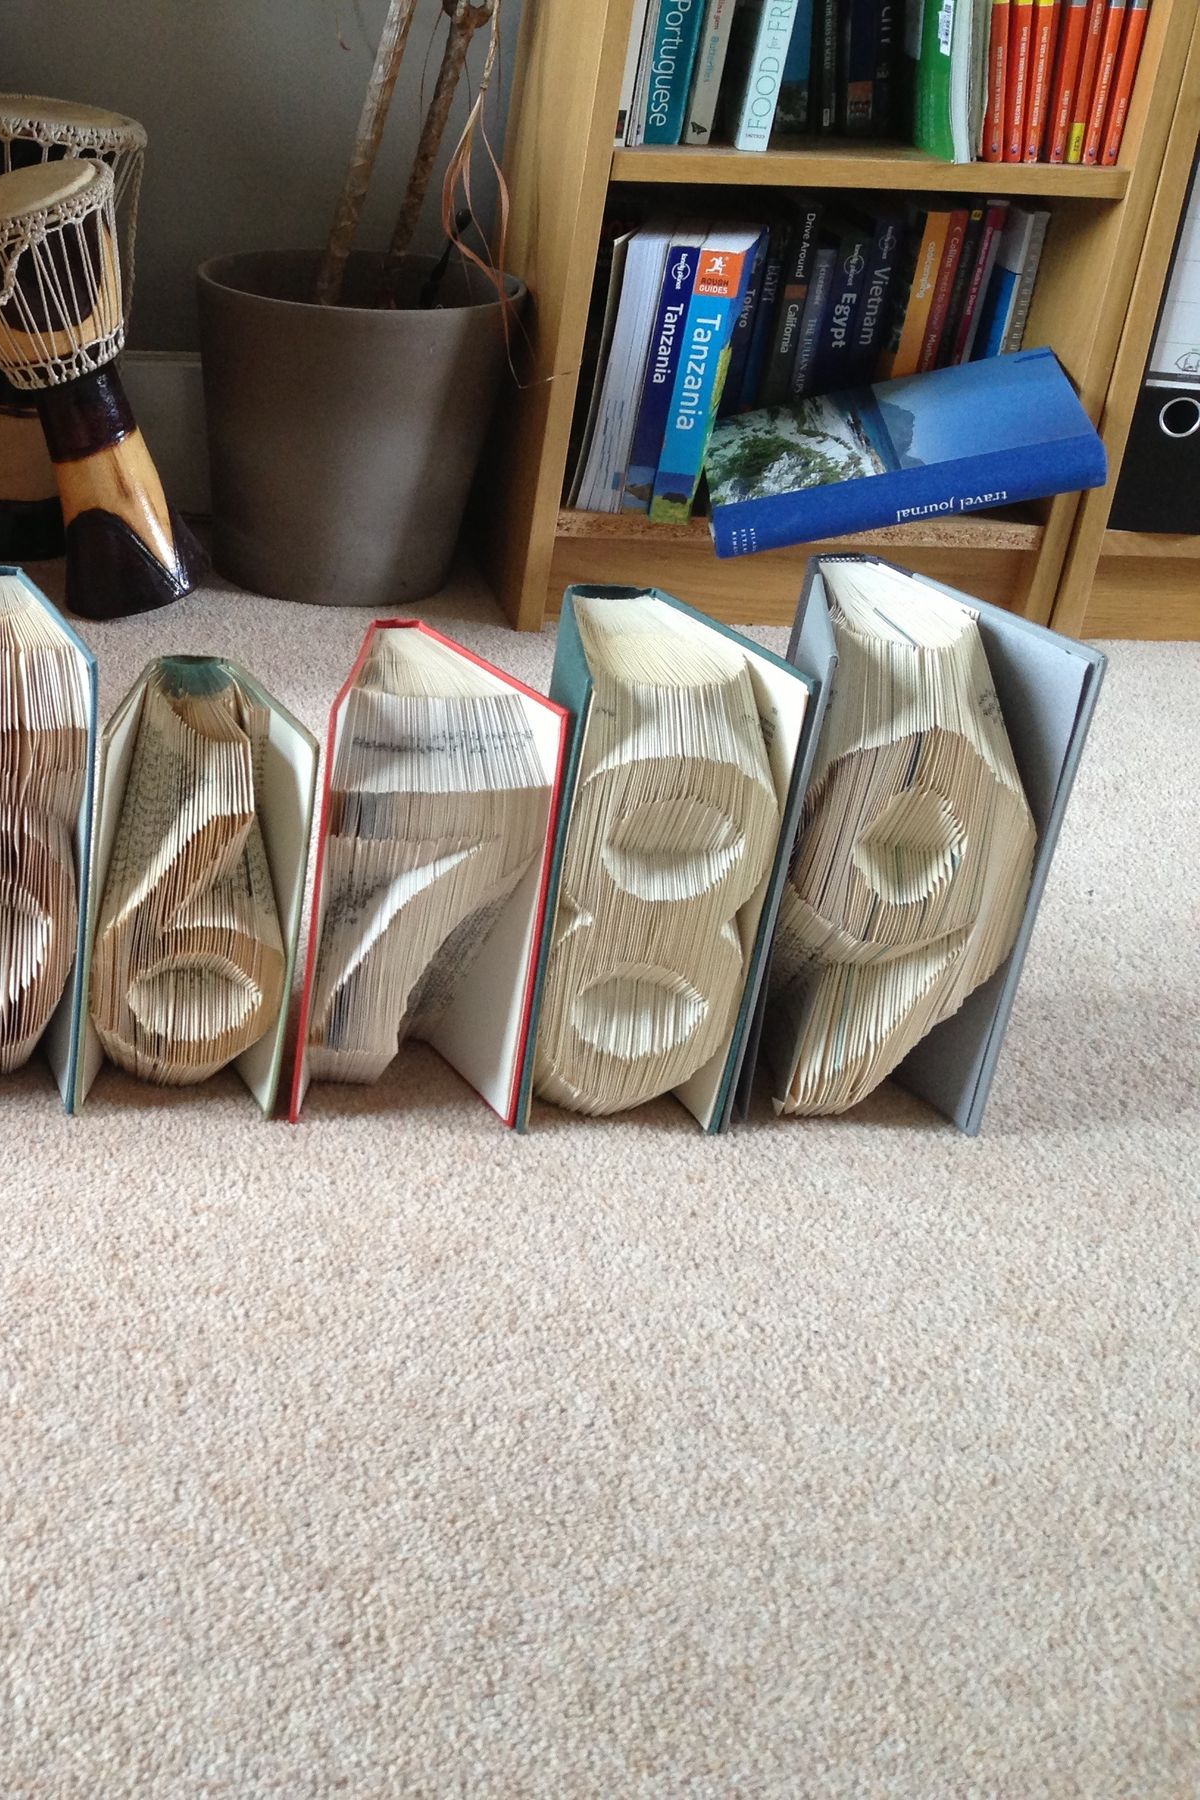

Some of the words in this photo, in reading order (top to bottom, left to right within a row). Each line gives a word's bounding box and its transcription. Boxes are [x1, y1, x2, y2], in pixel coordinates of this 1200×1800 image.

[767, 0, 793, 31] FR
[767, 37, 780, 50] for
[648, 0, 692, 127] Portuguese
[747, 56, 780, 130] FOOD
[802, 212, 816, 240] Drive
[795, 241, 810, 278] Around
[945, 237, 960, 268] Collins
[698, 284, 728, 294] GUIDES
[700, 277, 729, 287] ROUGH
[738, 288, 756, 328] Tokyo
[830, 292, 858, 349] Egypt
[858, 266, 892, 345] Vietnam
[652, 303, 684, 384] Tanzania
[779, 303, 799, 353] California
[675, 313, 722, 431] Tanzania
[896, 496, 955, 523] journal
[960, 490, 1008, 510] travel
[91, 812, 284, 1084] 6
[309, 787, 552, 1086] 7
[536, 756, 780, 1115] 8
[780, 725, 1038, 1115] 9
